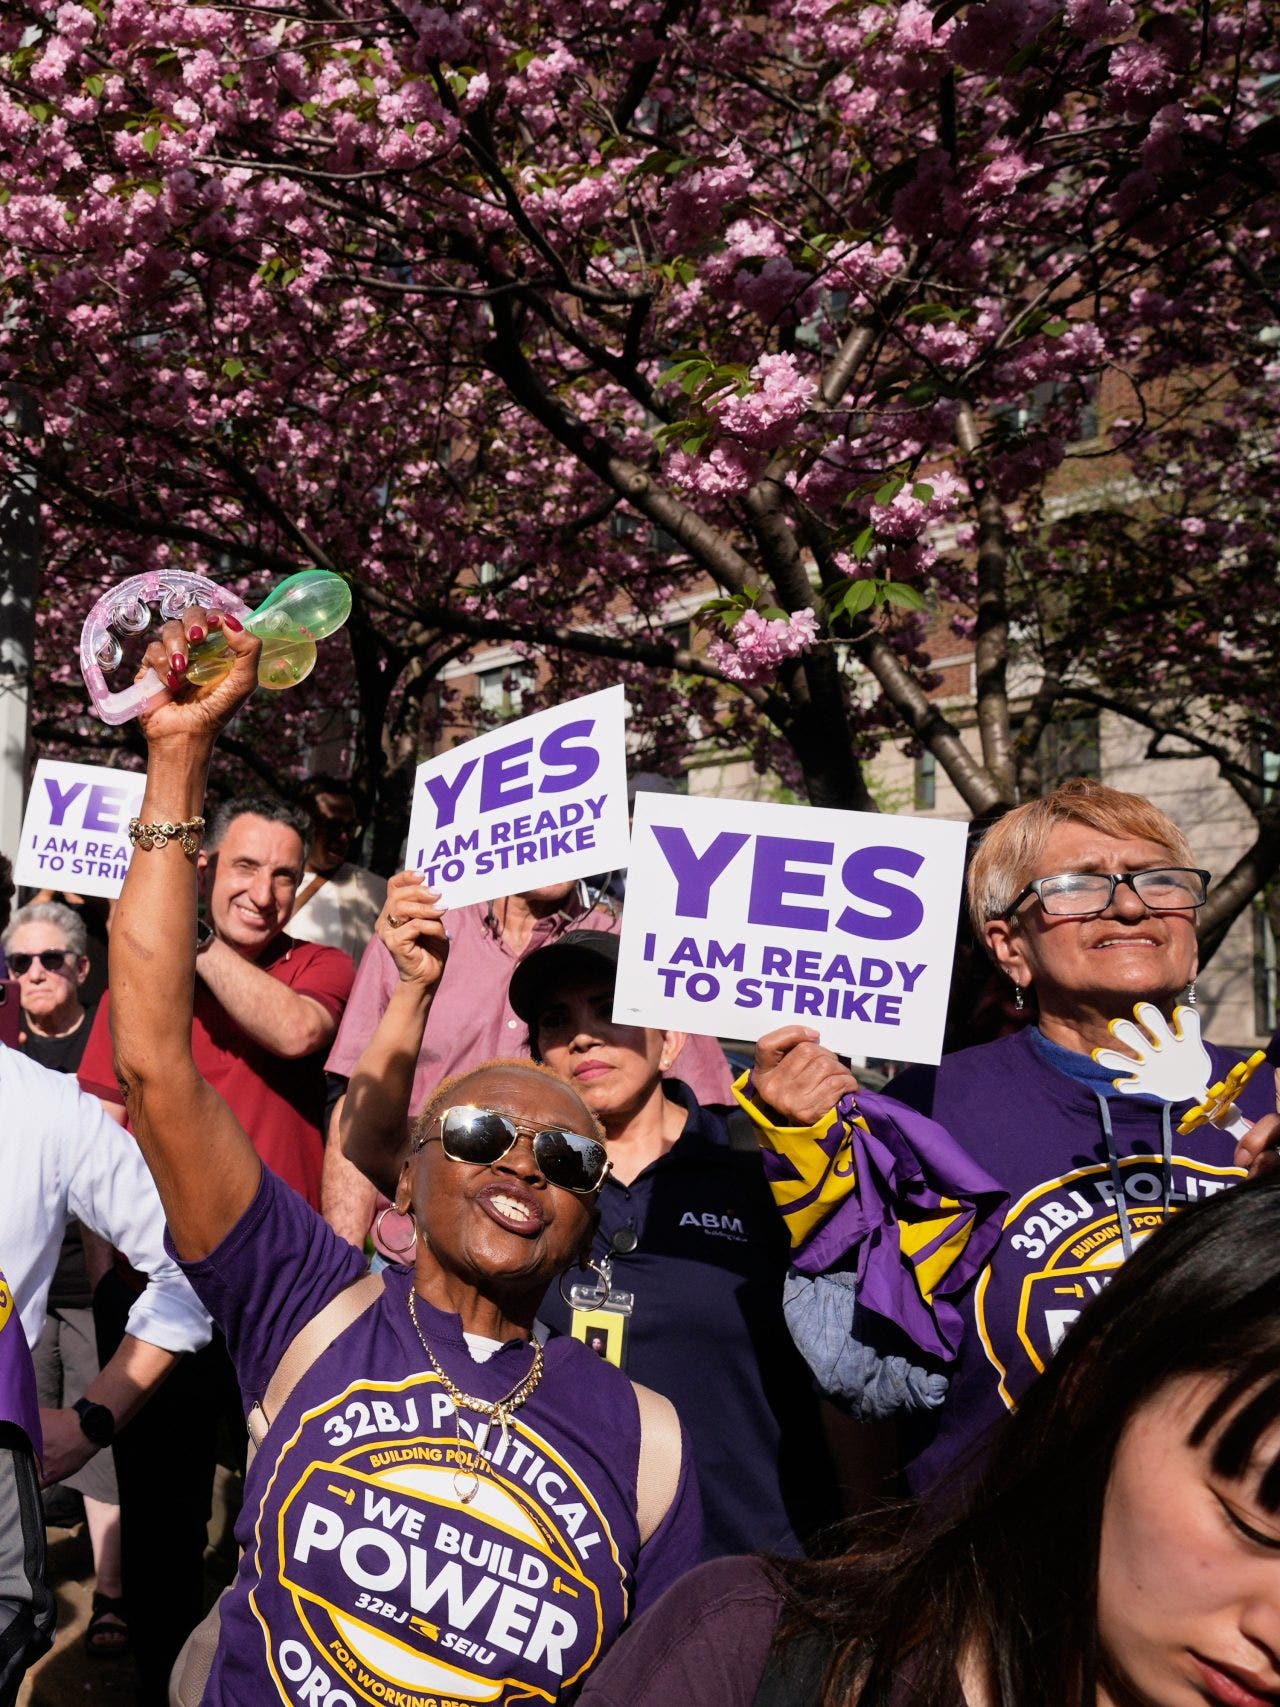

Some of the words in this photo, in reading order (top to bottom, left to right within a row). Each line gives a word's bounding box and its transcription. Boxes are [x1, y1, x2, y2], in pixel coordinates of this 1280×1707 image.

[424, 718, 600, 830] YES
[32, 835, 38, 849] I
[44, 837, 78, 855] AM
[85, 842, 128, 861] REA
[38, 854, 65, 871] TO
[418, 848, 425, 868] I
[431, 826, 480, 864] AM
[490, 794, 608, 847] READY
[424, 860, 465, 888] TO
[475, 824, 596, 876] STRIKE
[649, 824, 926, 941] YES
[643, 932, 657, 962] I
[669, 937, 745, 973] AM
[761, 945, 928, 994] READY
[657, 968, 721, 1004] TO
[734, 976, 903, 1027] STRIKE
[678, 1211, 745, 1234] ABM
[1010, 1190, 1094, 1259] 32BJ
[323, 1397, 420, 1447] 32BJ
[369, 1446, 443, 1468] BUILDING
[362, 1489, 427, 1539] WE
[434, 1525, 549, 1590] BUILD
[293, 1502, 579, 1676] POWER
[354, 1592, 408, 1625] 32BJ
[439, 1632, 497, 1666] SEIU
[329, 1639, 358, 1674] FOR
[357, 1668, 438, 1707] WORKING
